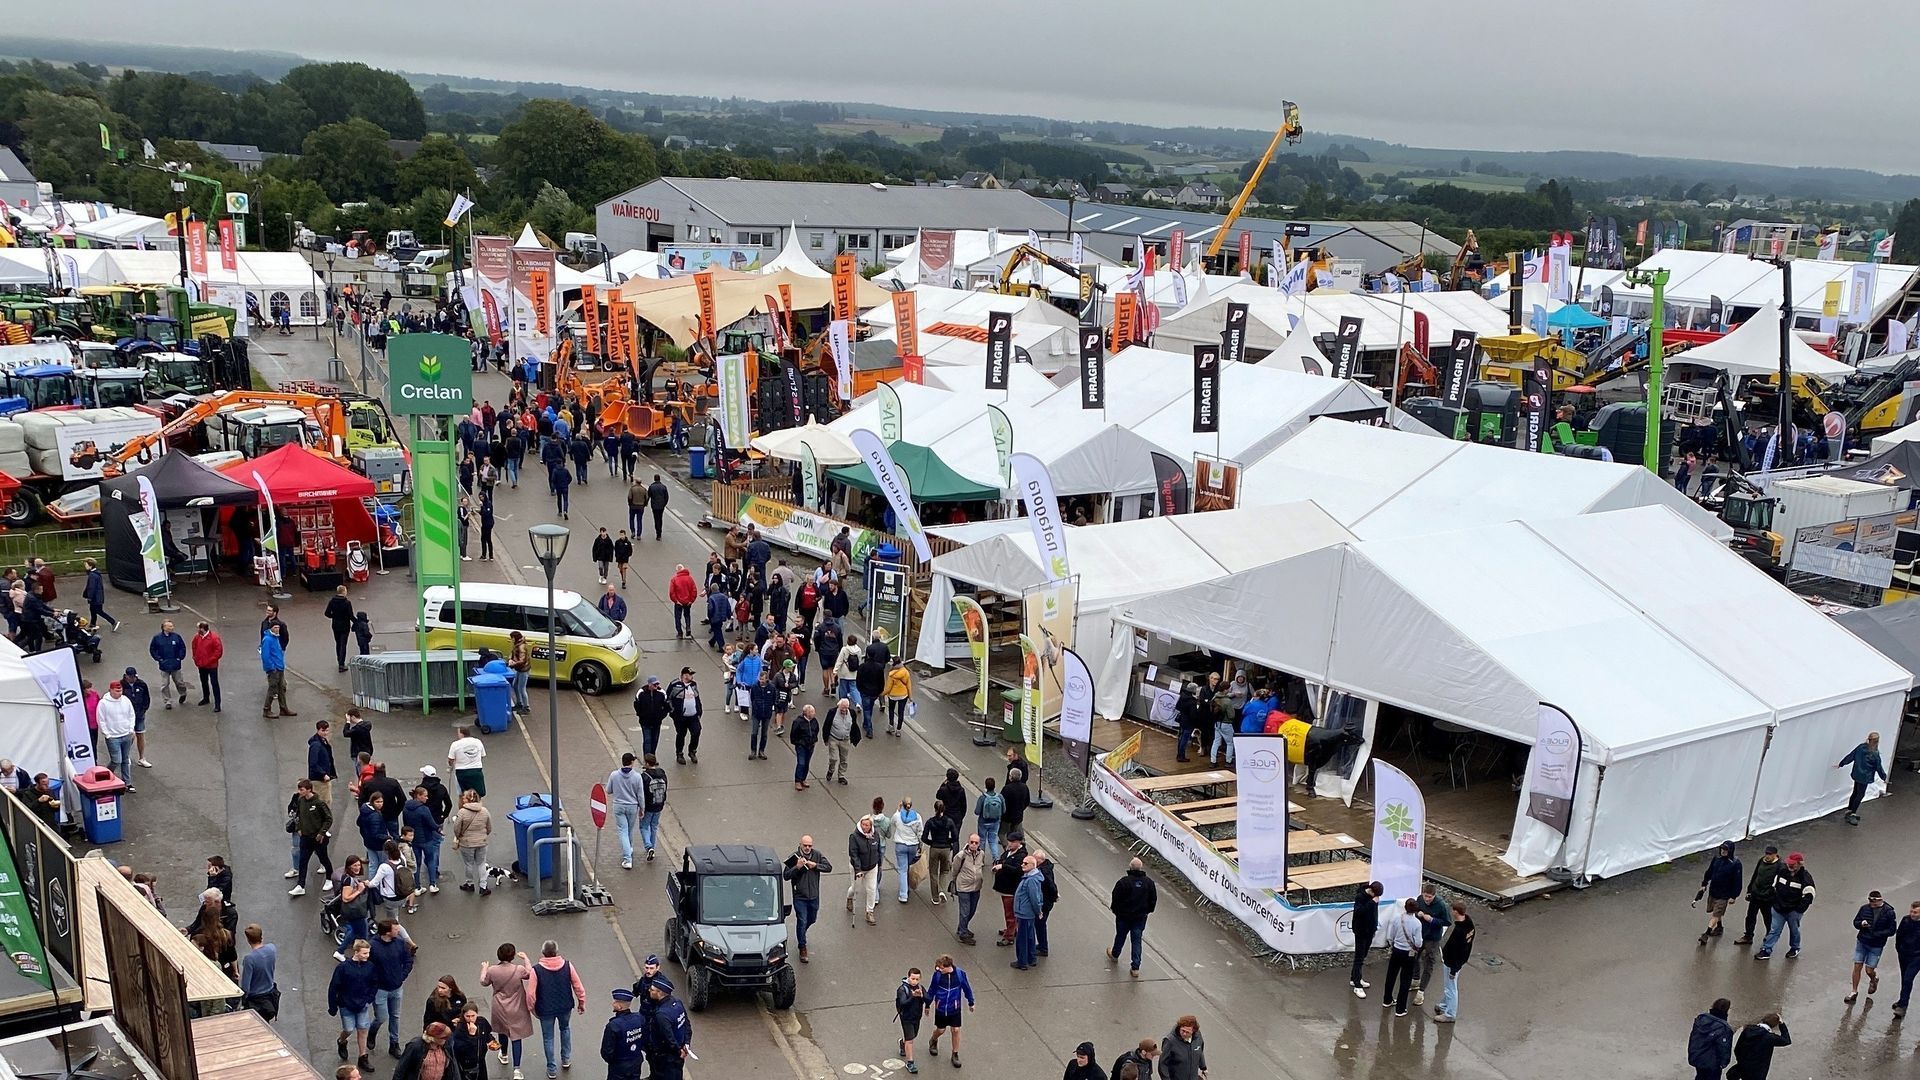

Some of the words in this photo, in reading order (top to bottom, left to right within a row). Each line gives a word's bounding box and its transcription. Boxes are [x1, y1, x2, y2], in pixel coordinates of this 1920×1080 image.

[612, 203, 660, 222] WAMEROU
[992, 340, 1004, 383] PIRAGRI
[1230, 329, 1240, 361] IRAGRI
[400, 384, 463, 399] Crelan
[1087, 357, 1098, 402] PIRAGRI
[1201, 377, 1212, 425] PIRAGRI
[1449, 358, 1464, 402] PIRAGRI
[755, 503, 774, 518] VOTRE
[1091, 770, 1104, 790] Stop
[1136, 808, 1145, 822] de
[1161, 824, 1185, 853] fermes
[1189, 847, 1209, 875] toutes
[1209, 868, 1219, 883] et
[1221, 875, 1239, 898] tous
[1241, 892, 1285, 933] concernés
[1290, 921, 1295, 935] !
